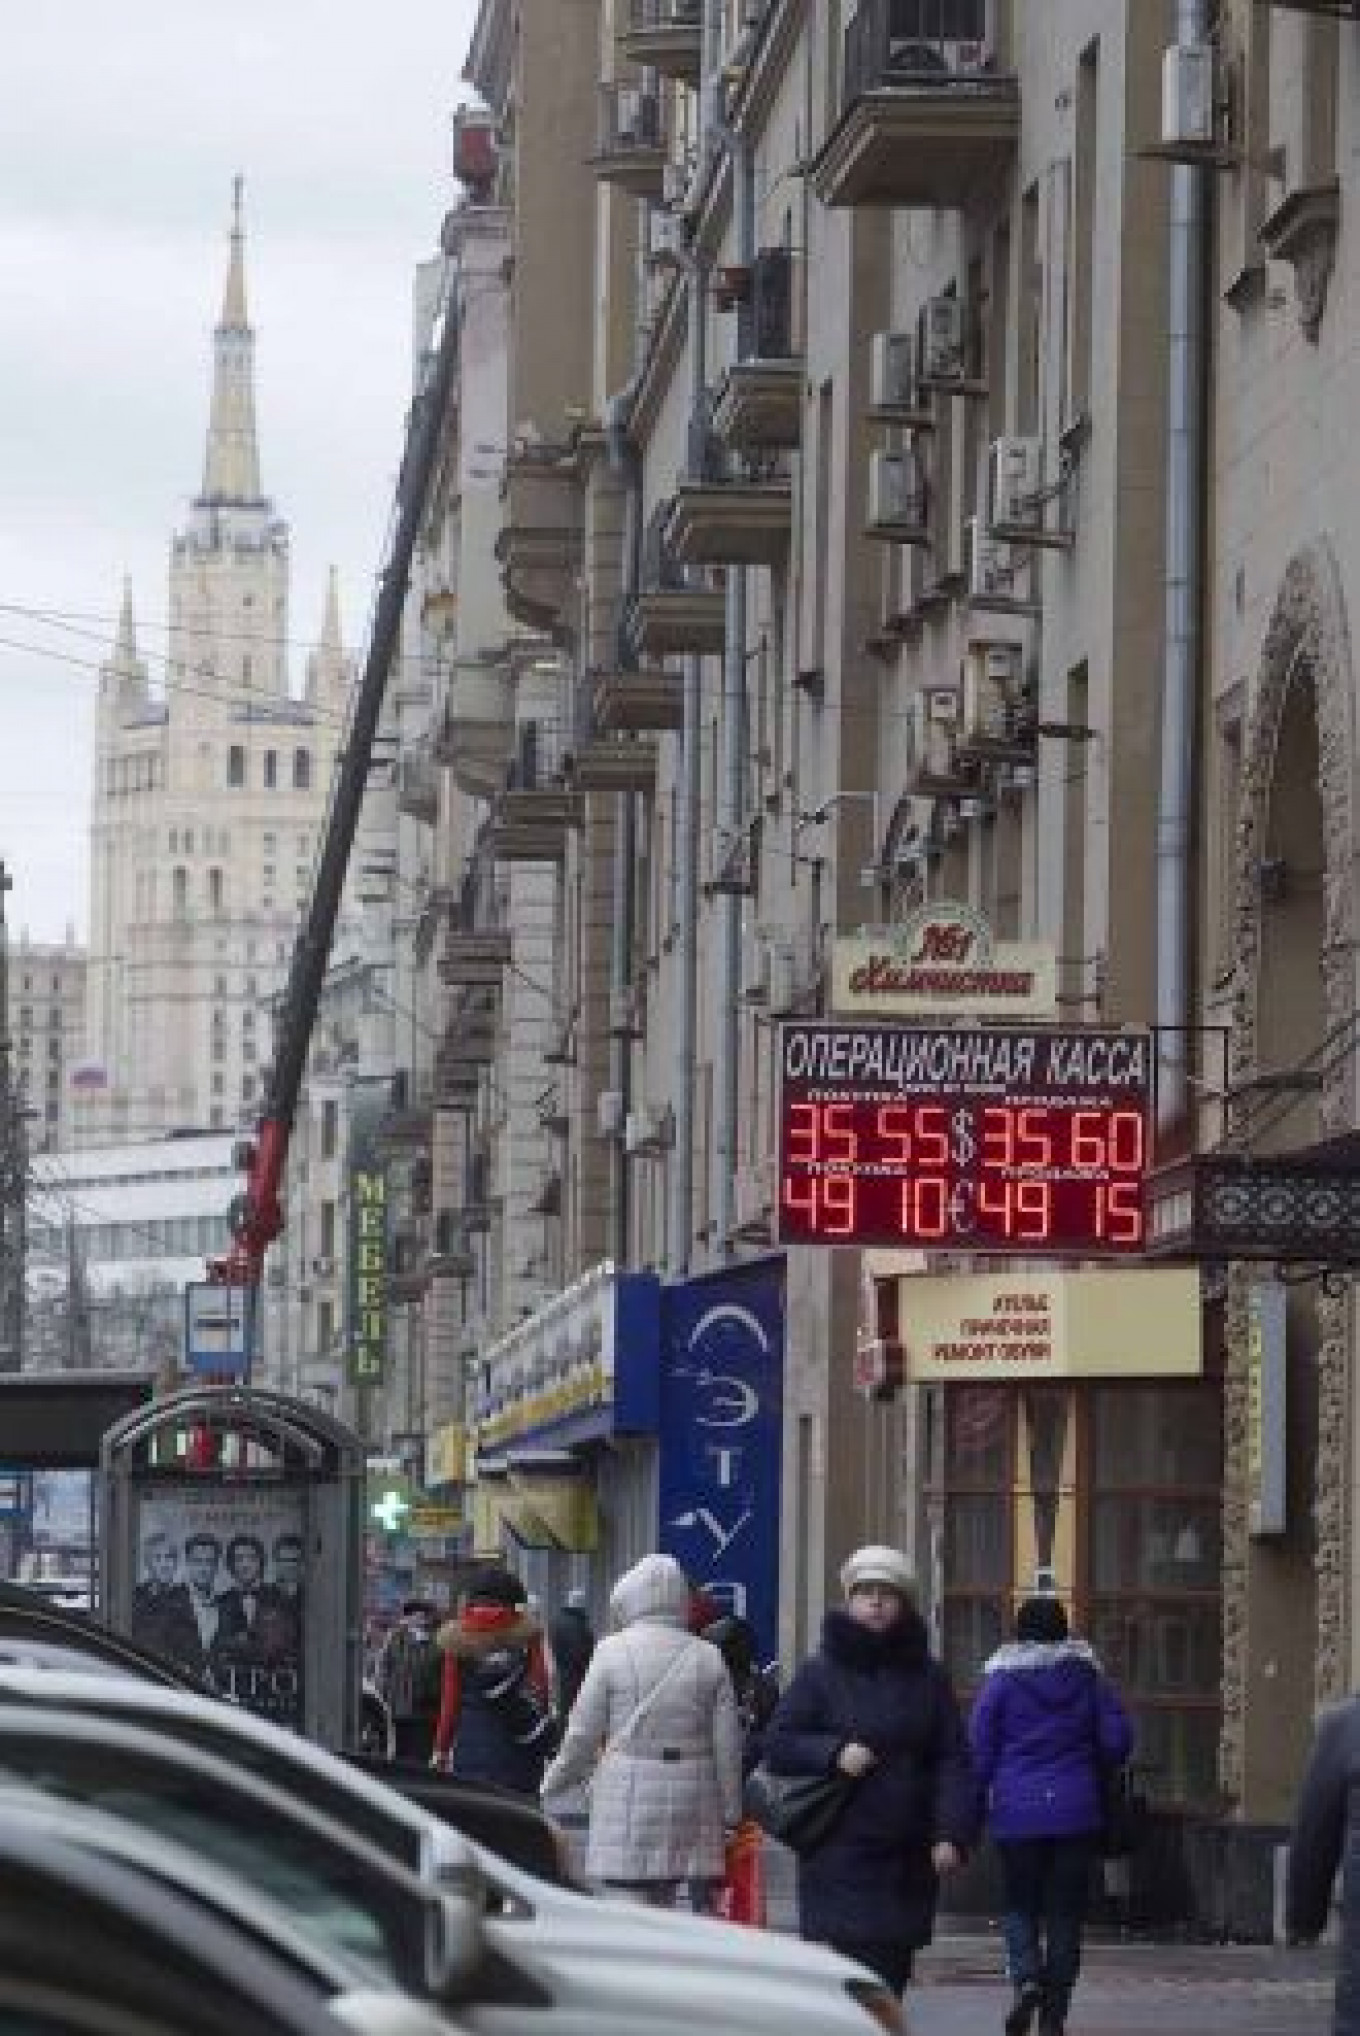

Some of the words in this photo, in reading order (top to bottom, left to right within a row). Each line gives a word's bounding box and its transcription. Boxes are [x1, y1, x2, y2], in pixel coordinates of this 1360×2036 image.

[786, 1033, 1035, 1087] ОПЕРАЦИОННАЯ
[1046, 1041, 1143, 1085] КАССА
[790, 1104, 857, 1163] 35
[877, 1107, 949, 1164] 55
[951, 1107, 976, 1168] $
[984, 1107, 1051, 1168] 35
[1070, 1111, 1143, 1172] 60
[784, 1178, 854, 1234] 49
[901, 1178, 945, 1237] 10
[980, 1182, 1049, 1238] 49
[1095, 1182, 1139, 1242] 15
[357, 1172, 385, 1376] МЕБЕЛЬ
